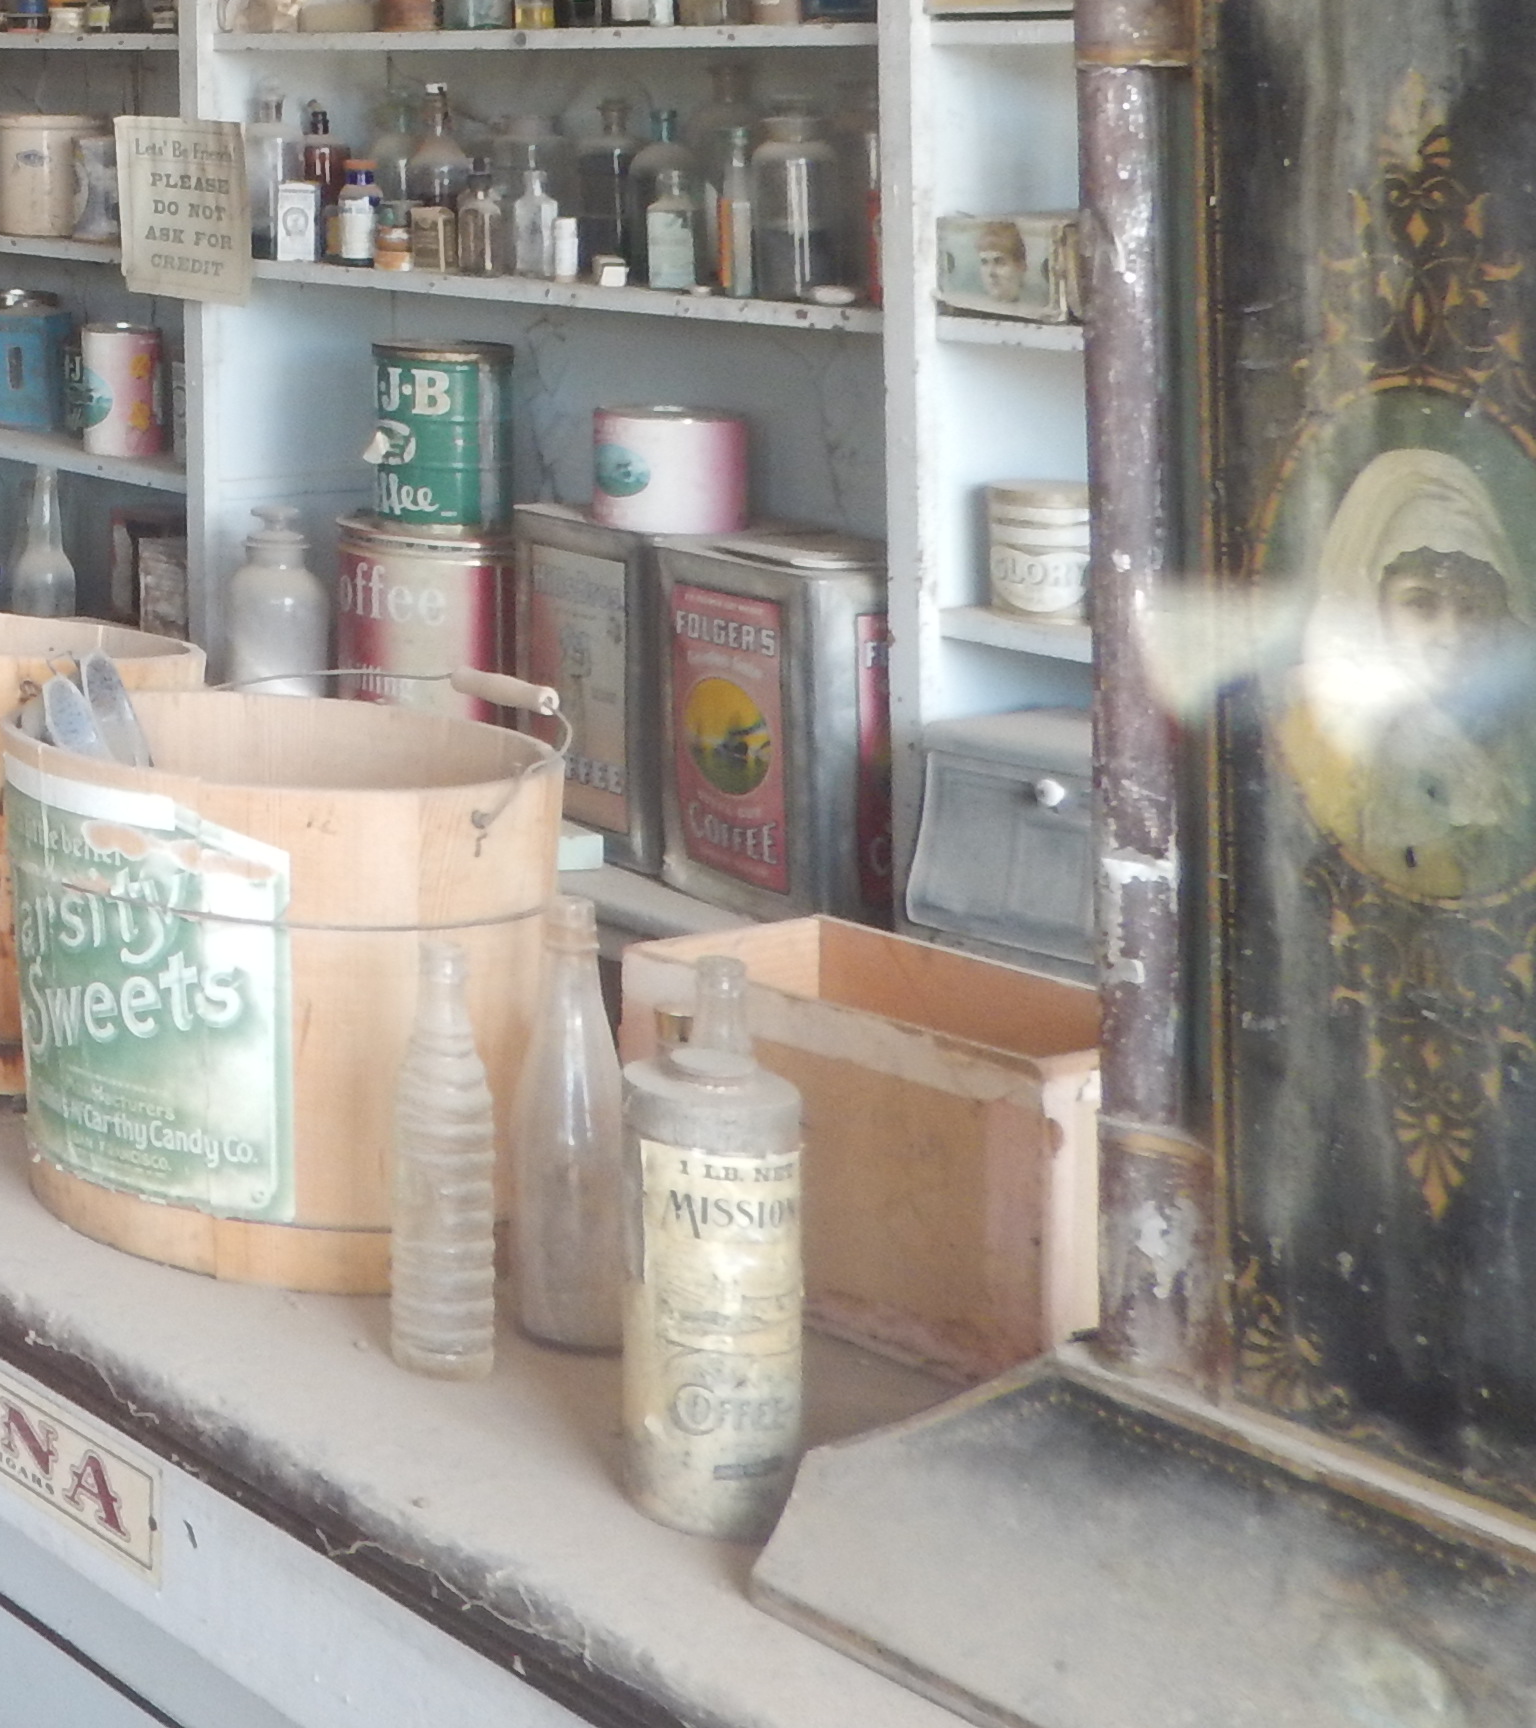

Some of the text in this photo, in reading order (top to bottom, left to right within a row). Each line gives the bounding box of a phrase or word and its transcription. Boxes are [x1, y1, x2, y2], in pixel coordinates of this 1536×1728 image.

[172, 139, 189, 158] Be
[150, 172, 230, 195] PLEASE
[153, 199, 227, 221] DO NOT
[145, 225, 233, 250] ASK FOR
[150, 253, 224, 277] CREDIT
[688, 799, 777, 866] COFFEE
[24, 952, 243, 1062] Sweets
[149, 1121, 221, 1169] Candy
[223, 1135, 259, 1165] Co.
[679, 1159, 689, 1175] 1
[753, 1162, 794, 1183] NET
[661, 1188, 796, 1240] MISSION
